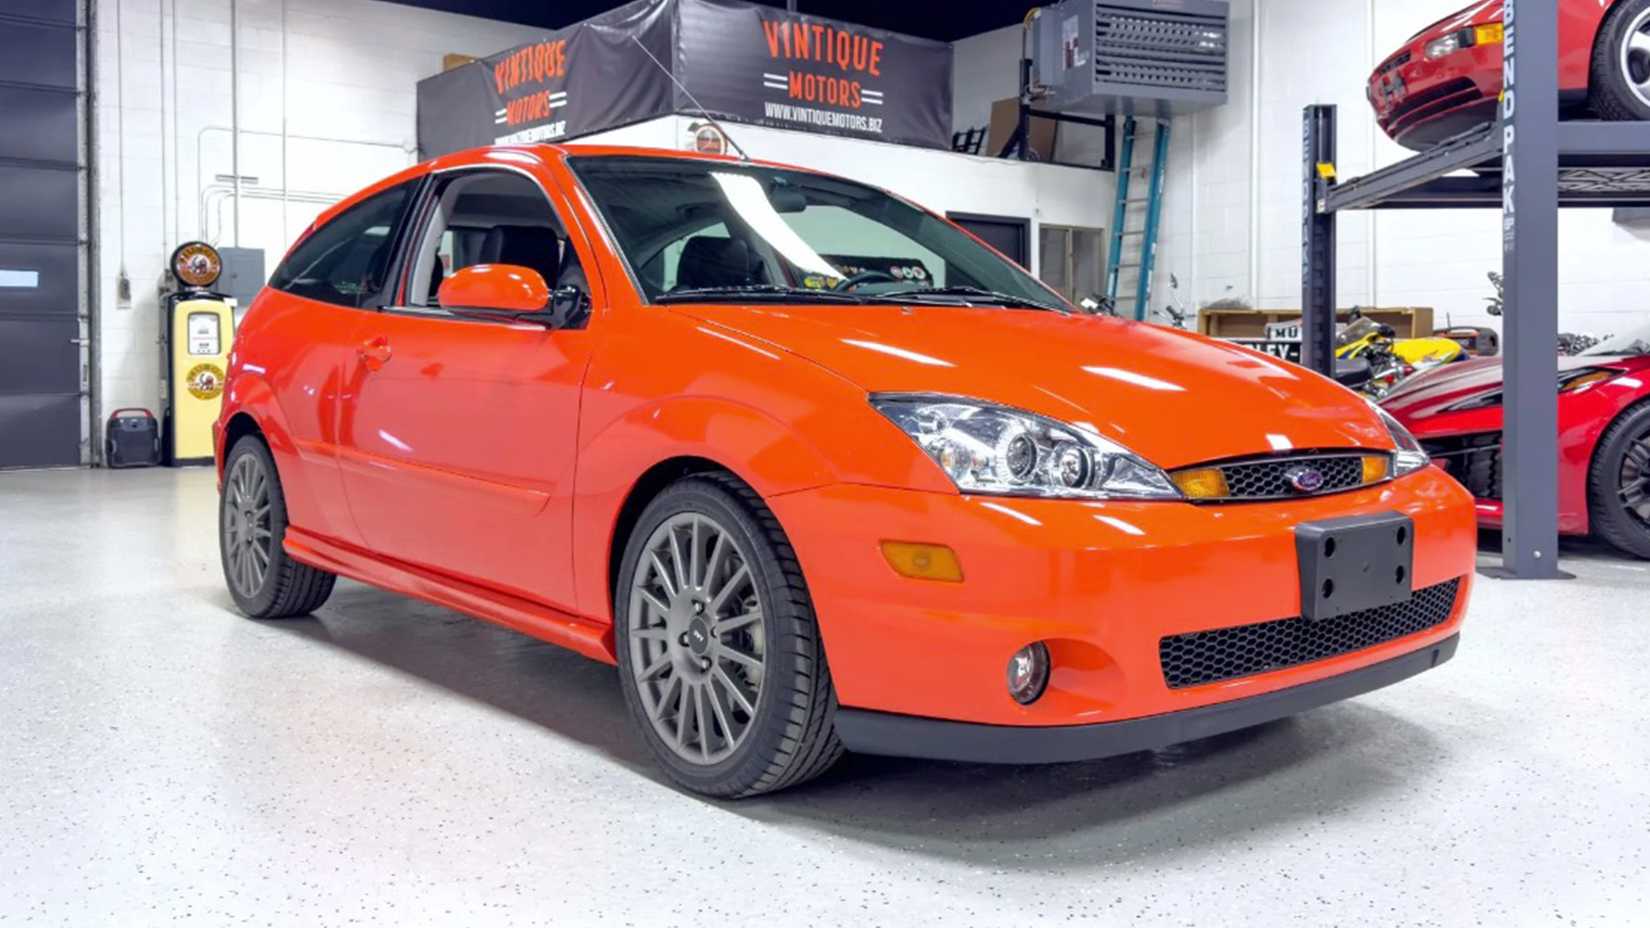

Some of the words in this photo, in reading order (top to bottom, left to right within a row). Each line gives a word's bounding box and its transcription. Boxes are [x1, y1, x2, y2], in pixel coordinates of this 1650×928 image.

[494, 38, 567, 96] VINTIQUE
[763, 19, 883, 77] VINTIQUE
[506, 89, 550, 127] MOTORS
[788, 71, 862, 109] MOTORS
[764, 102, 883, 133] WWW.VINTIQUEMOTORS.BIZ
